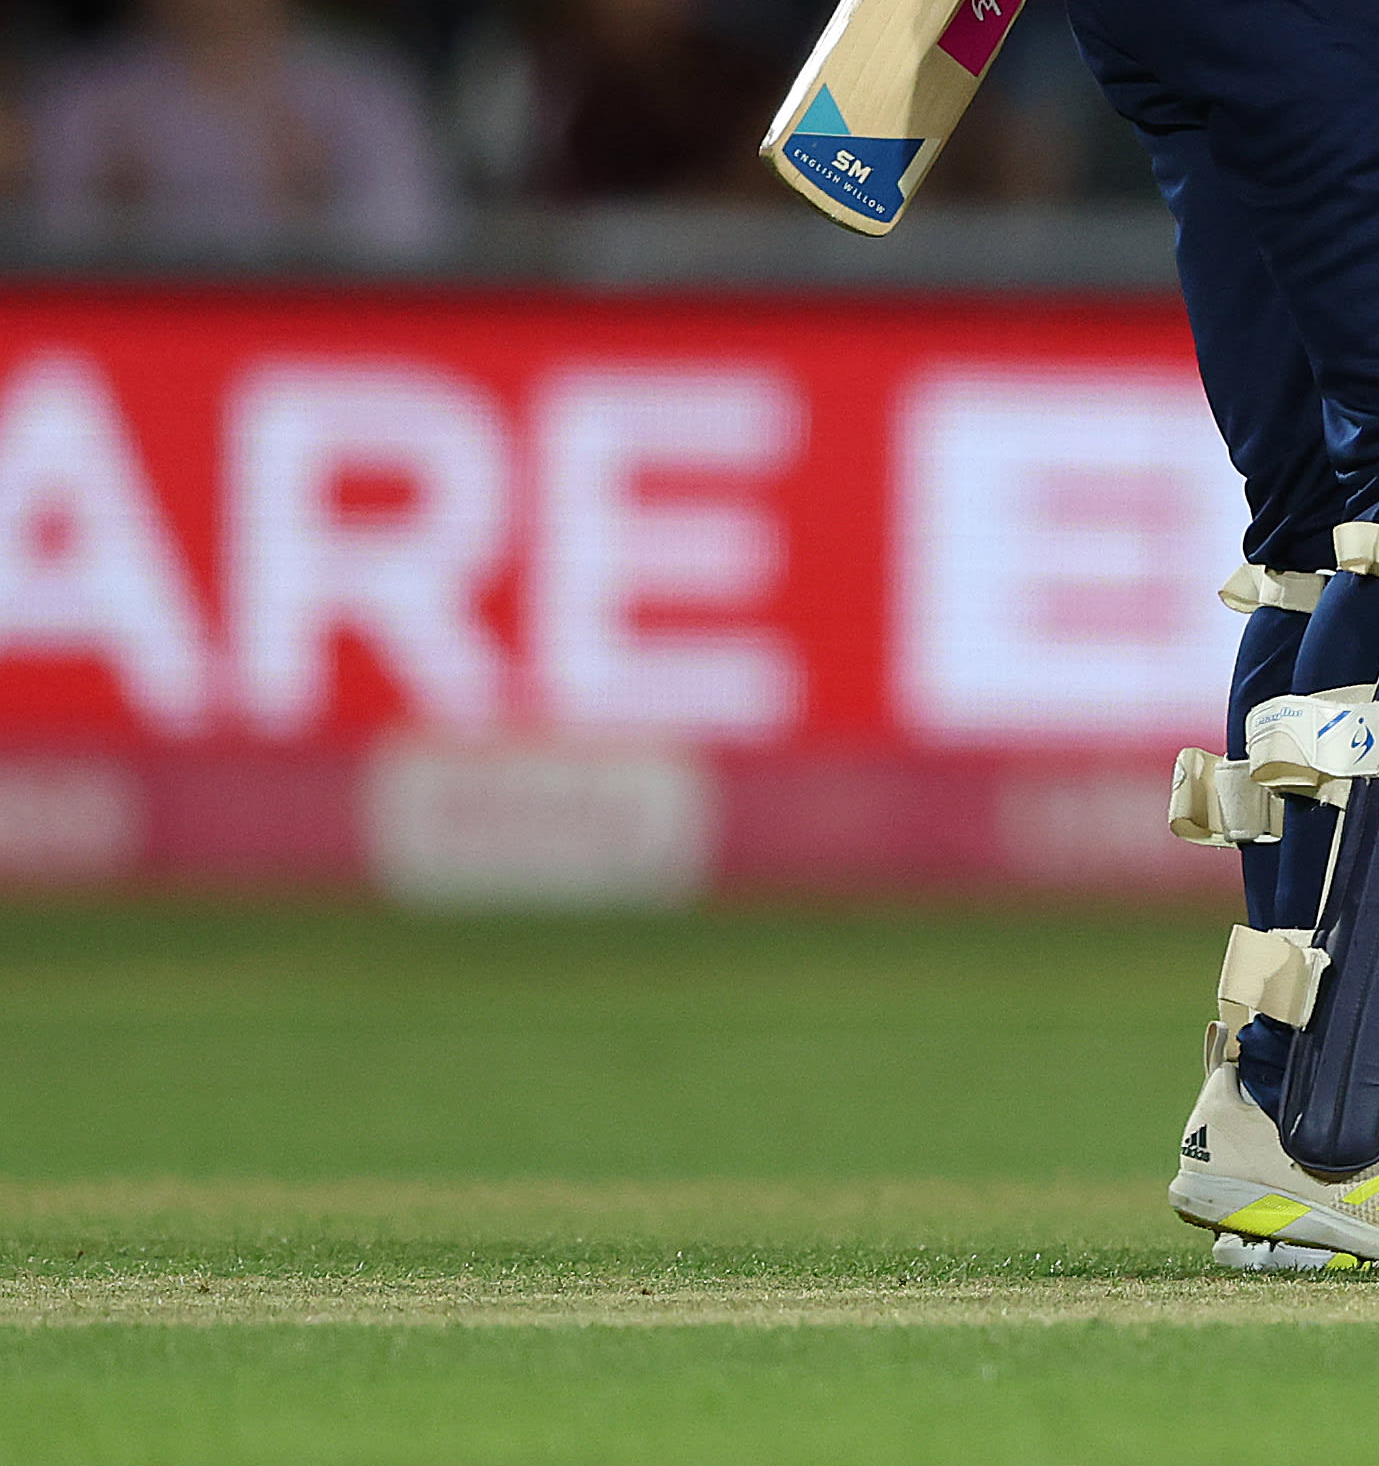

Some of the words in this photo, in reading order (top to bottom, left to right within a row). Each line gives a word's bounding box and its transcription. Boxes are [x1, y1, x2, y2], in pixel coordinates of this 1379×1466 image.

[793, 148, 841, 184] ENGLISH
[843, 181, 886, 214] WILLOW
[831, 149, 872, 184] SM
[0, 346, 812, 739] ARE
